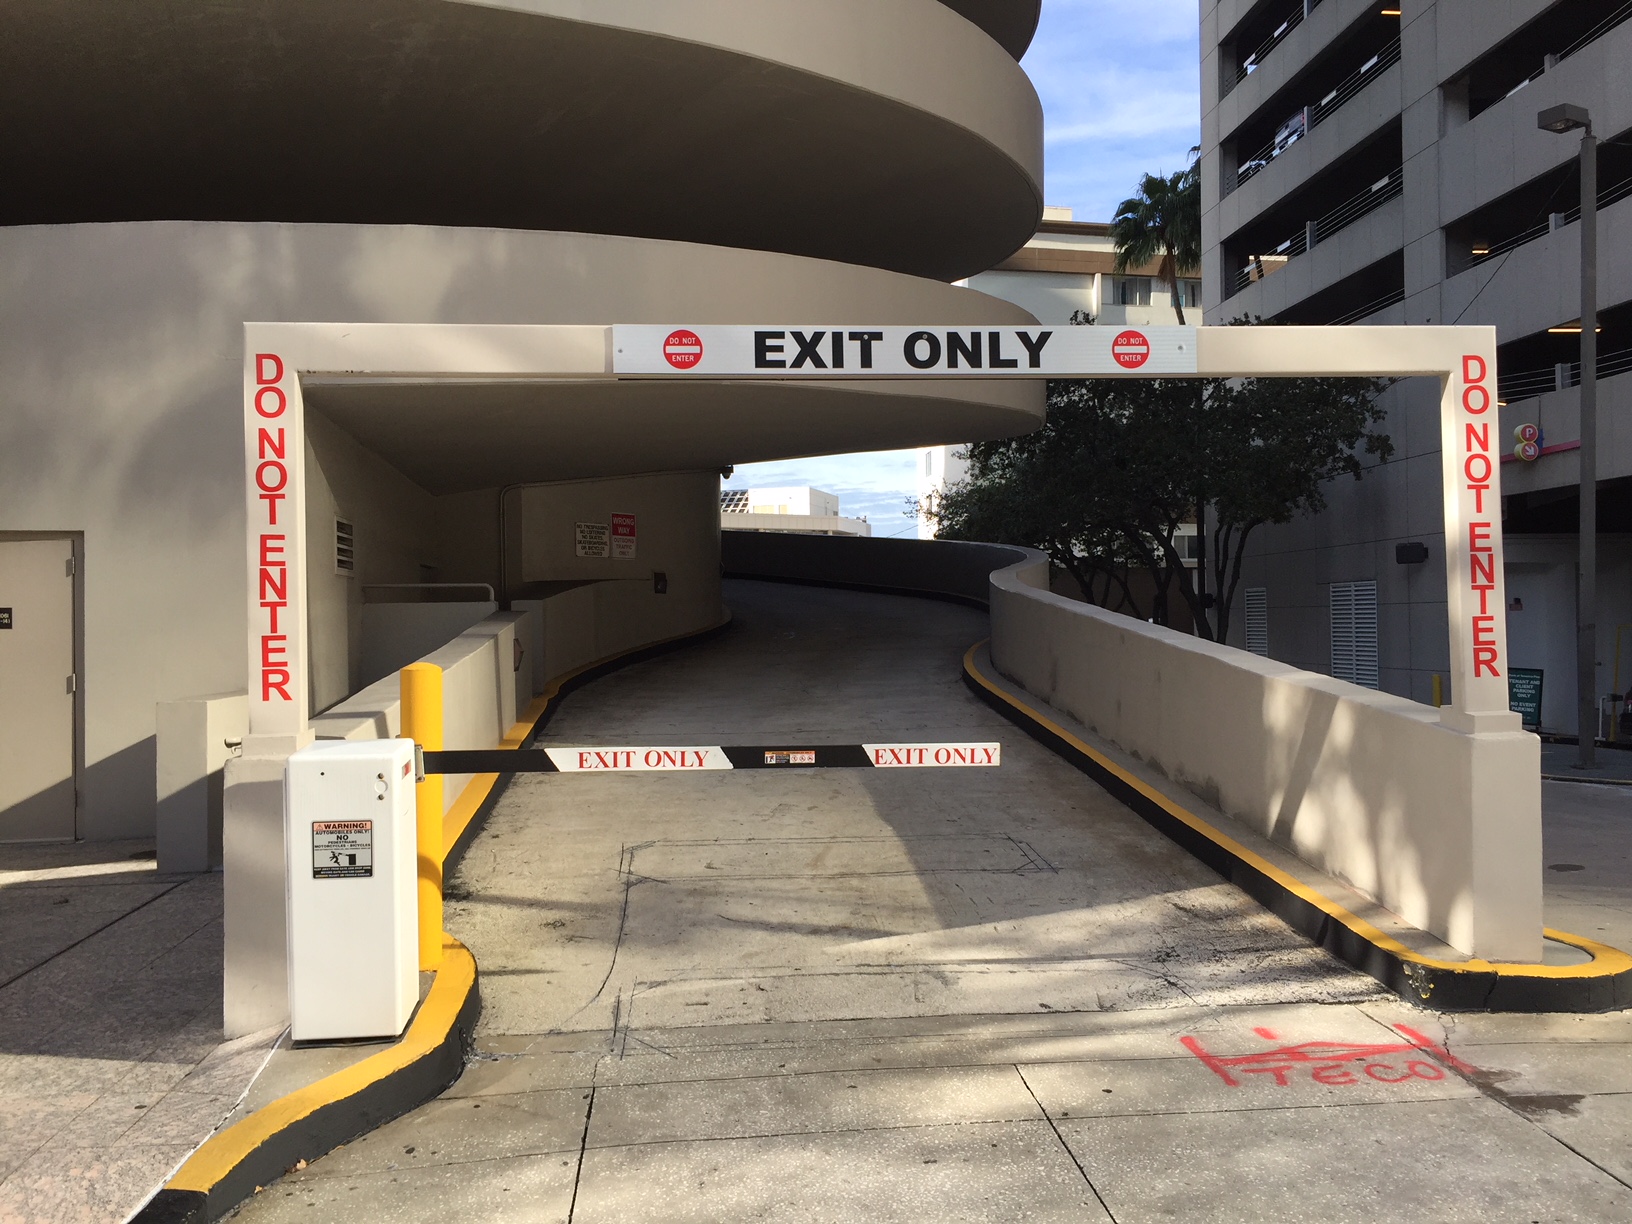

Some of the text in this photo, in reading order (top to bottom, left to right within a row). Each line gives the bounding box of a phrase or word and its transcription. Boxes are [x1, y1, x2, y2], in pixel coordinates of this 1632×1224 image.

[754, 331, 1053, 369] EXIT ONLY
[1526, 428, 1533, 438] P
[613, 517, 635, 526] WRONG
[1462, 355, 1501, 677] DO NOT ENTER
[254, 353, 293, 701] DO NOT ENTER
[617, 526, 630, 534] WAY
[578, 750, 709, 769] EXIT ONLY
[874, 747, 997, 765] EXIT ONLY
[1241, 1059, 1445, 1087] TECO
